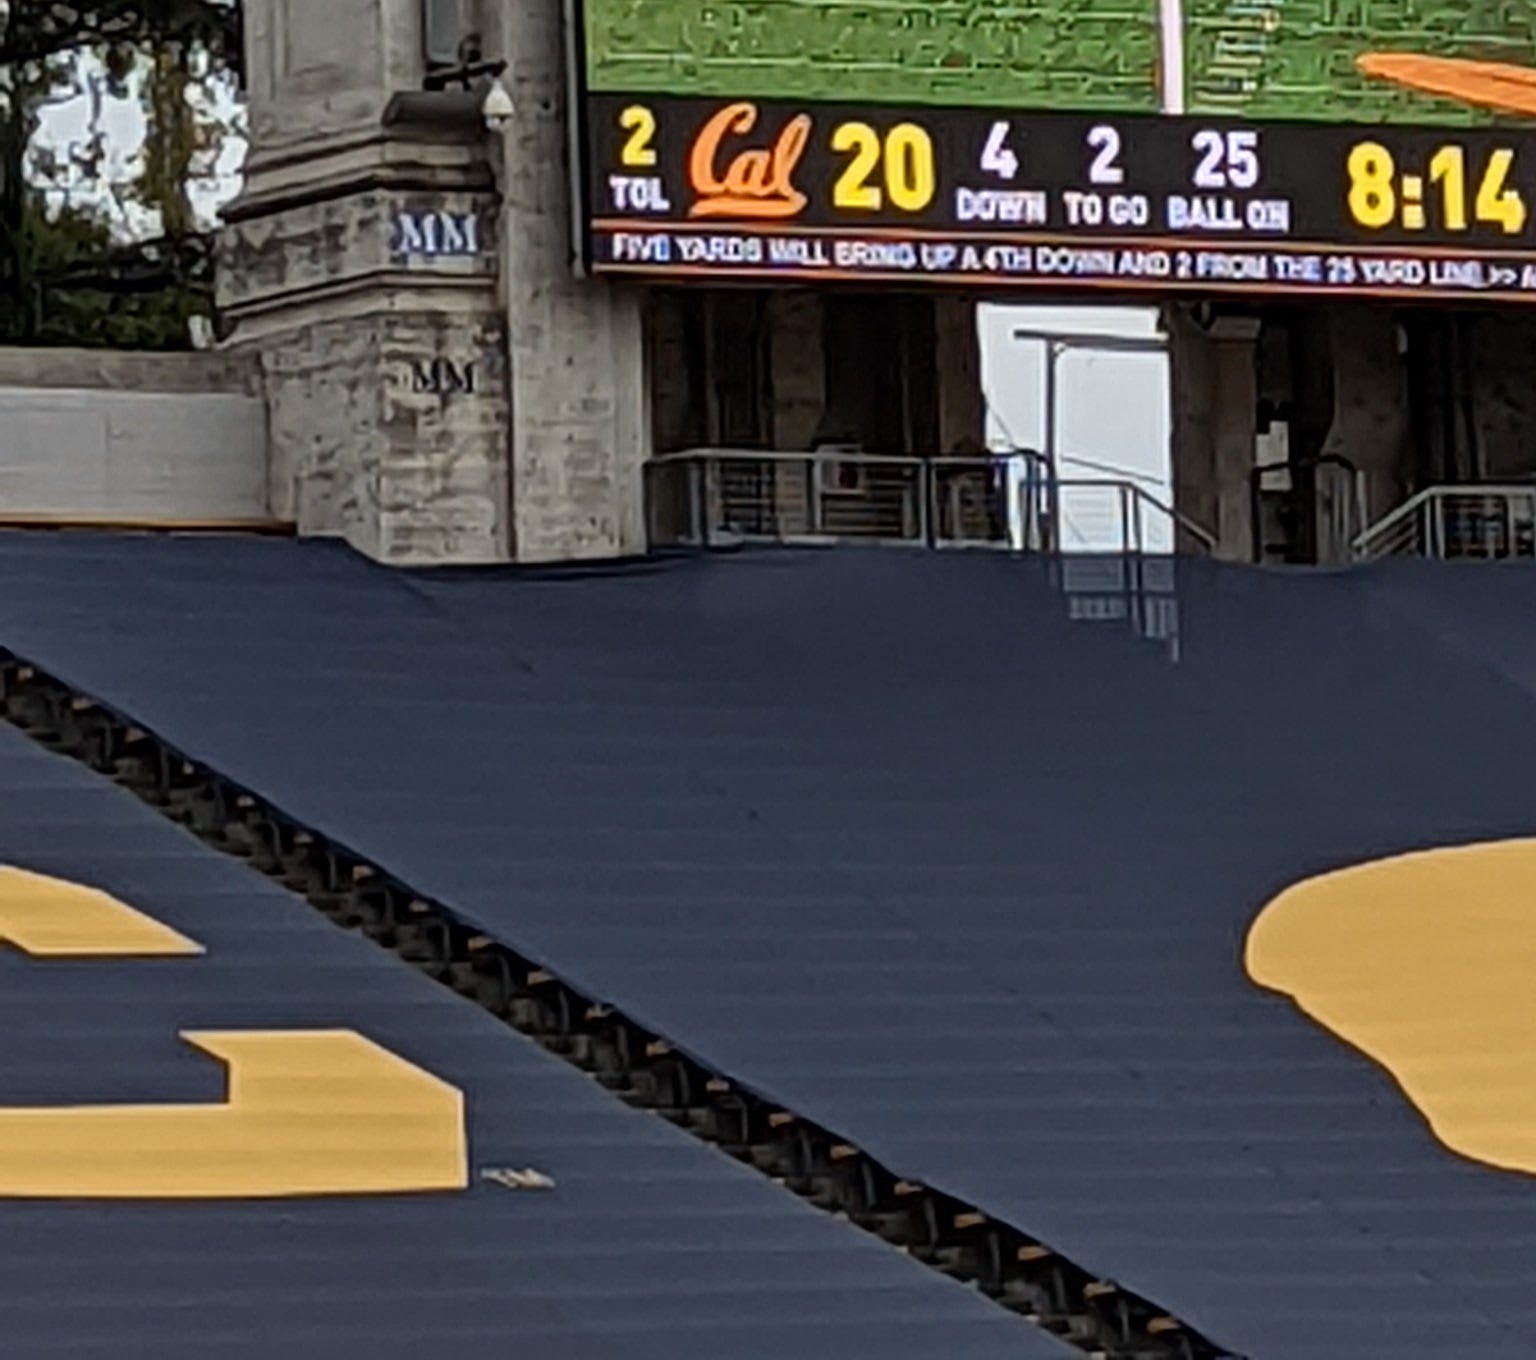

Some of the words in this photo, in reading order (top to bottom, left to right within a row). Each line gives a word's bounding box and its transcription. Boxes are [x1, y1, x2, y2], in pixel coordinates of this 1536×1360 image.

[619, 104, 656, 166] 2
[688, 102, 812, 218] Cal
[980, 121, 1018, 179] 4
[1087, 126, 1124, 183] 2
[1191, 130, 1258, 188] 25
[609, 176, 670, 211] TOL
[831, 122, 935, 211] 20
[1347, 141, 1526, 234] 8:14
[399, 214, 477, 252] MM
[956, 186, 1046, 224] DOWN
[1062, 191, 1101, 224] TO
[1109, 194, 1148, 225] GO
[1167, 195, 1243, 229] BALL
[1247, 200, 1290, 231] ON
[612, 233, 670, 261] FIVE
[676, 237, 762, 262] YARDS
[767, 238, 830, 266] WILL
[920, 243, 956, 270] UP
[961, 245, 980, 270] A
[1036, 247, 1115, 274] DOWN
[1118, 251, 1170, 277] AND
[1175, 252, 1192, 278] 2
[1273, 255, 1321, 281] THE
[1358, 258, 1426, 284] YARD
